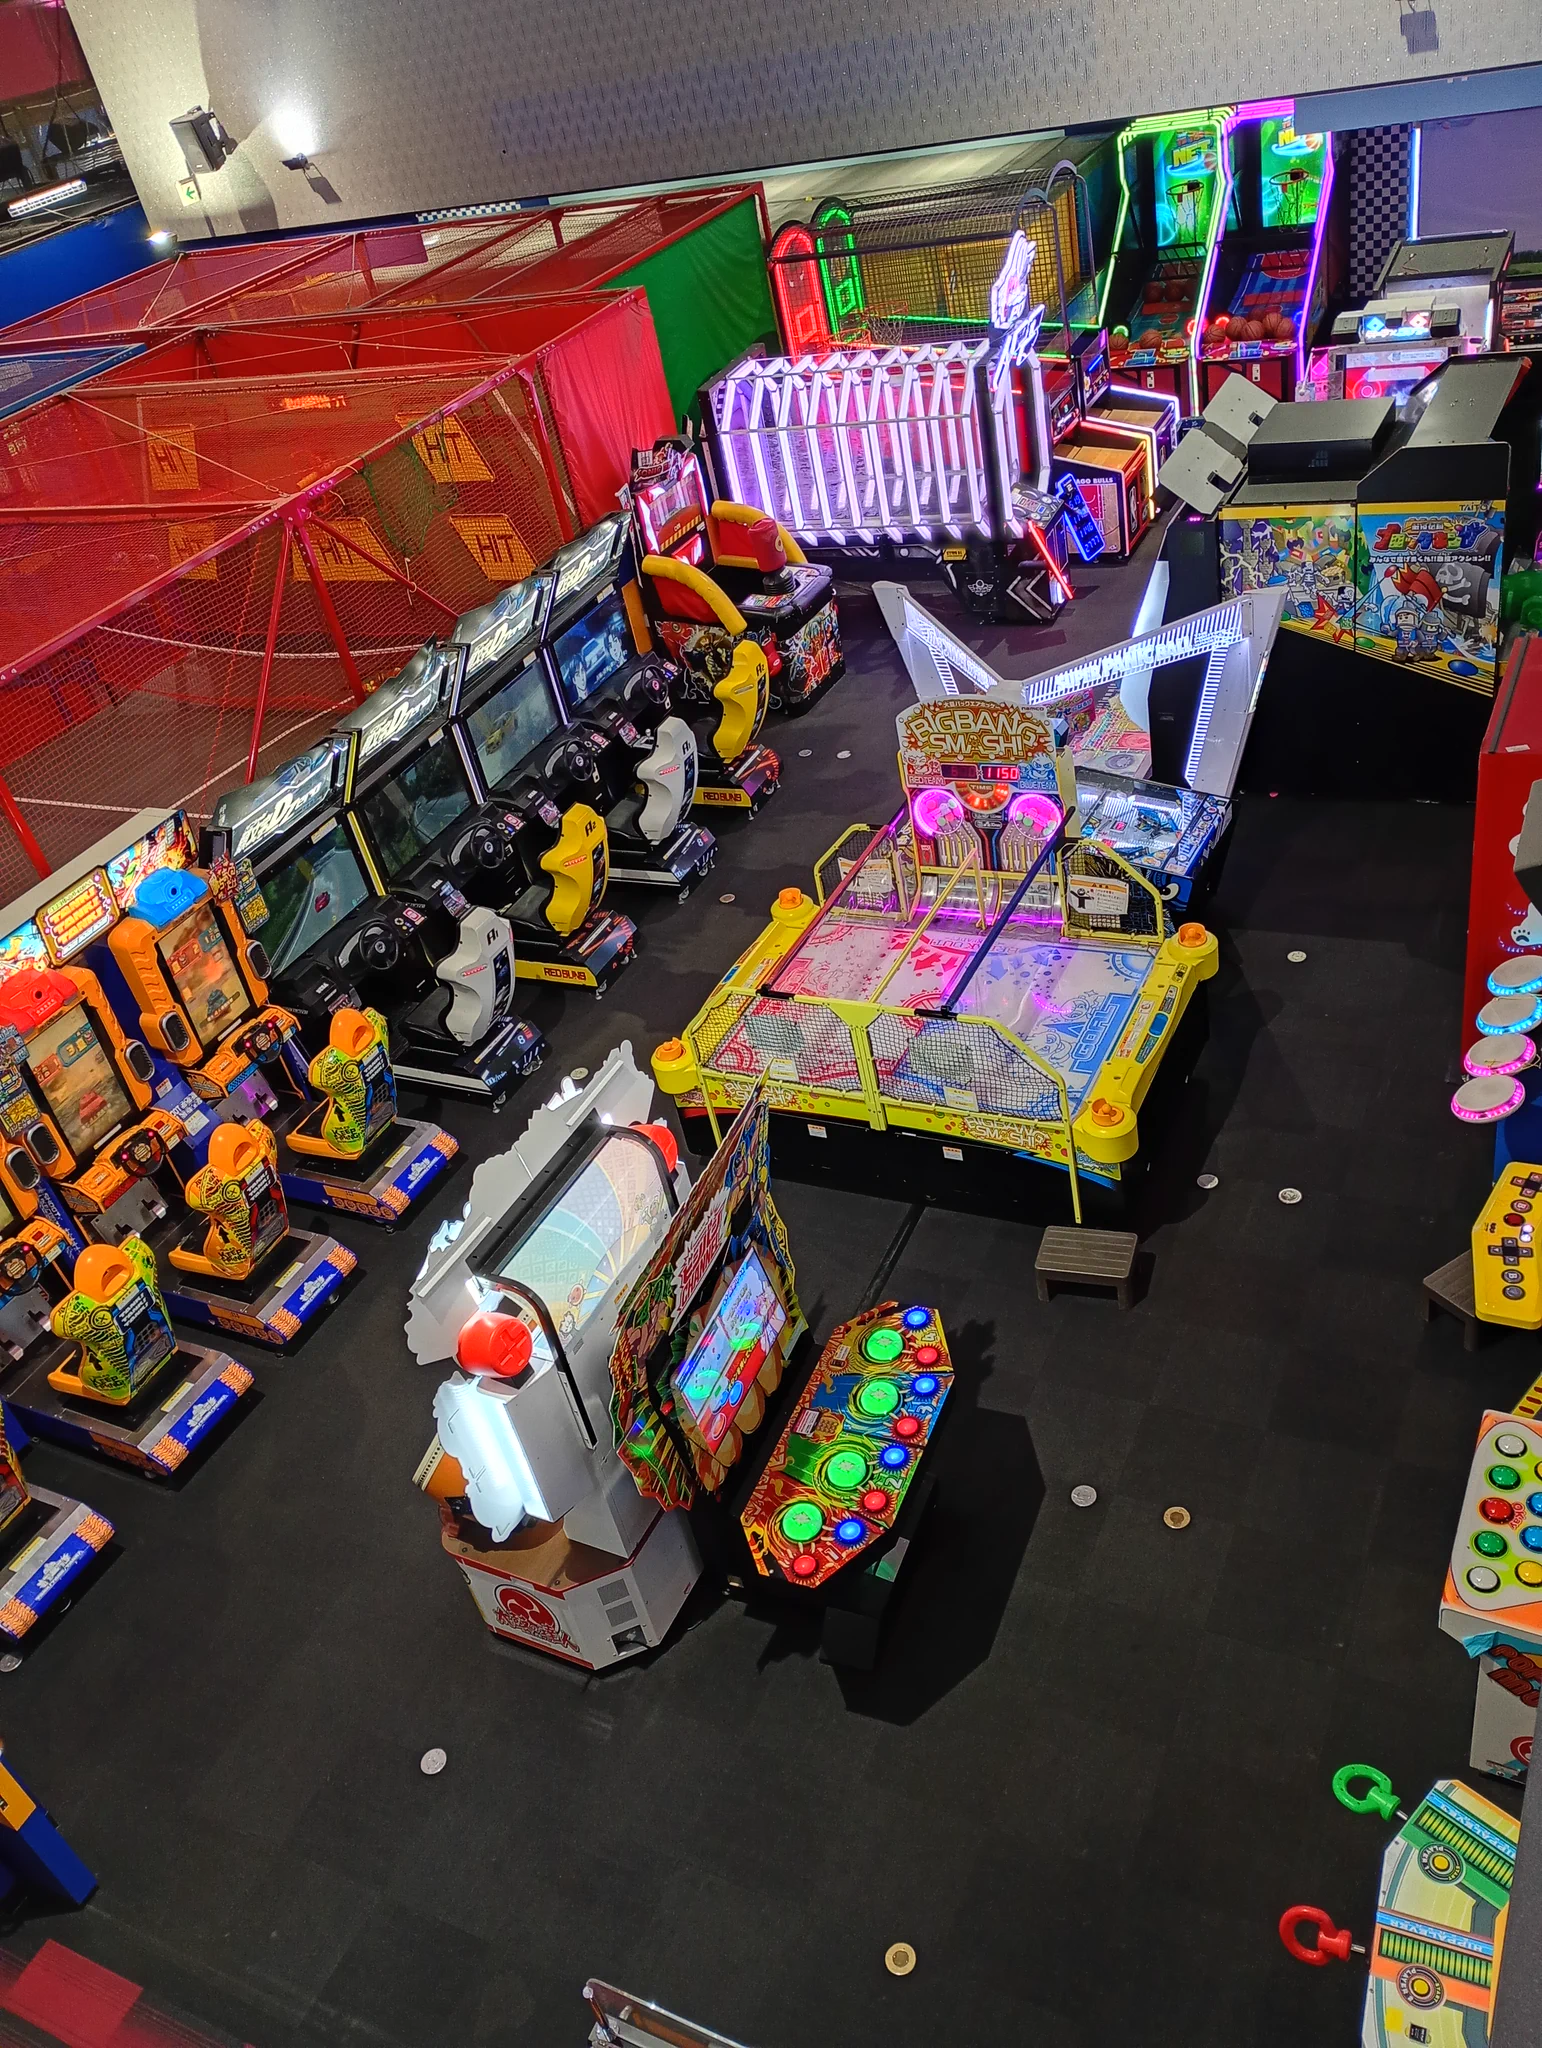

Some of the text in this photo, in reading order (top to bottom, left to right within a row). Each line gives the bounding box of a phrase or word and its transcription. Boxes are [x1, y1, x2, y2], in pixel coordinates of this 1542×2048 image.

[1173, 142, 1210, 167] NET
[152, 440, 188, 474] HIT
[423, 431, 462, 464] HIT
[475, 534, 514, 563] HIT
[909, 707, 1048, 748] BIGBANG
[929, 734, 1024, 757] SMASH!
[986, 766, 1019, 780] 1150
[1071, 1003, 1121, 1060] GOAL
[965, 1116, 1046, 1144] BIGBANG
[1421, 1844, 1445, 1865] PLAYER
[1447, 1864, 1461, 1881] START
[1400, 1967, 1418, 1994] PLAYER
[1433, 1981, 1441, 2003] START
